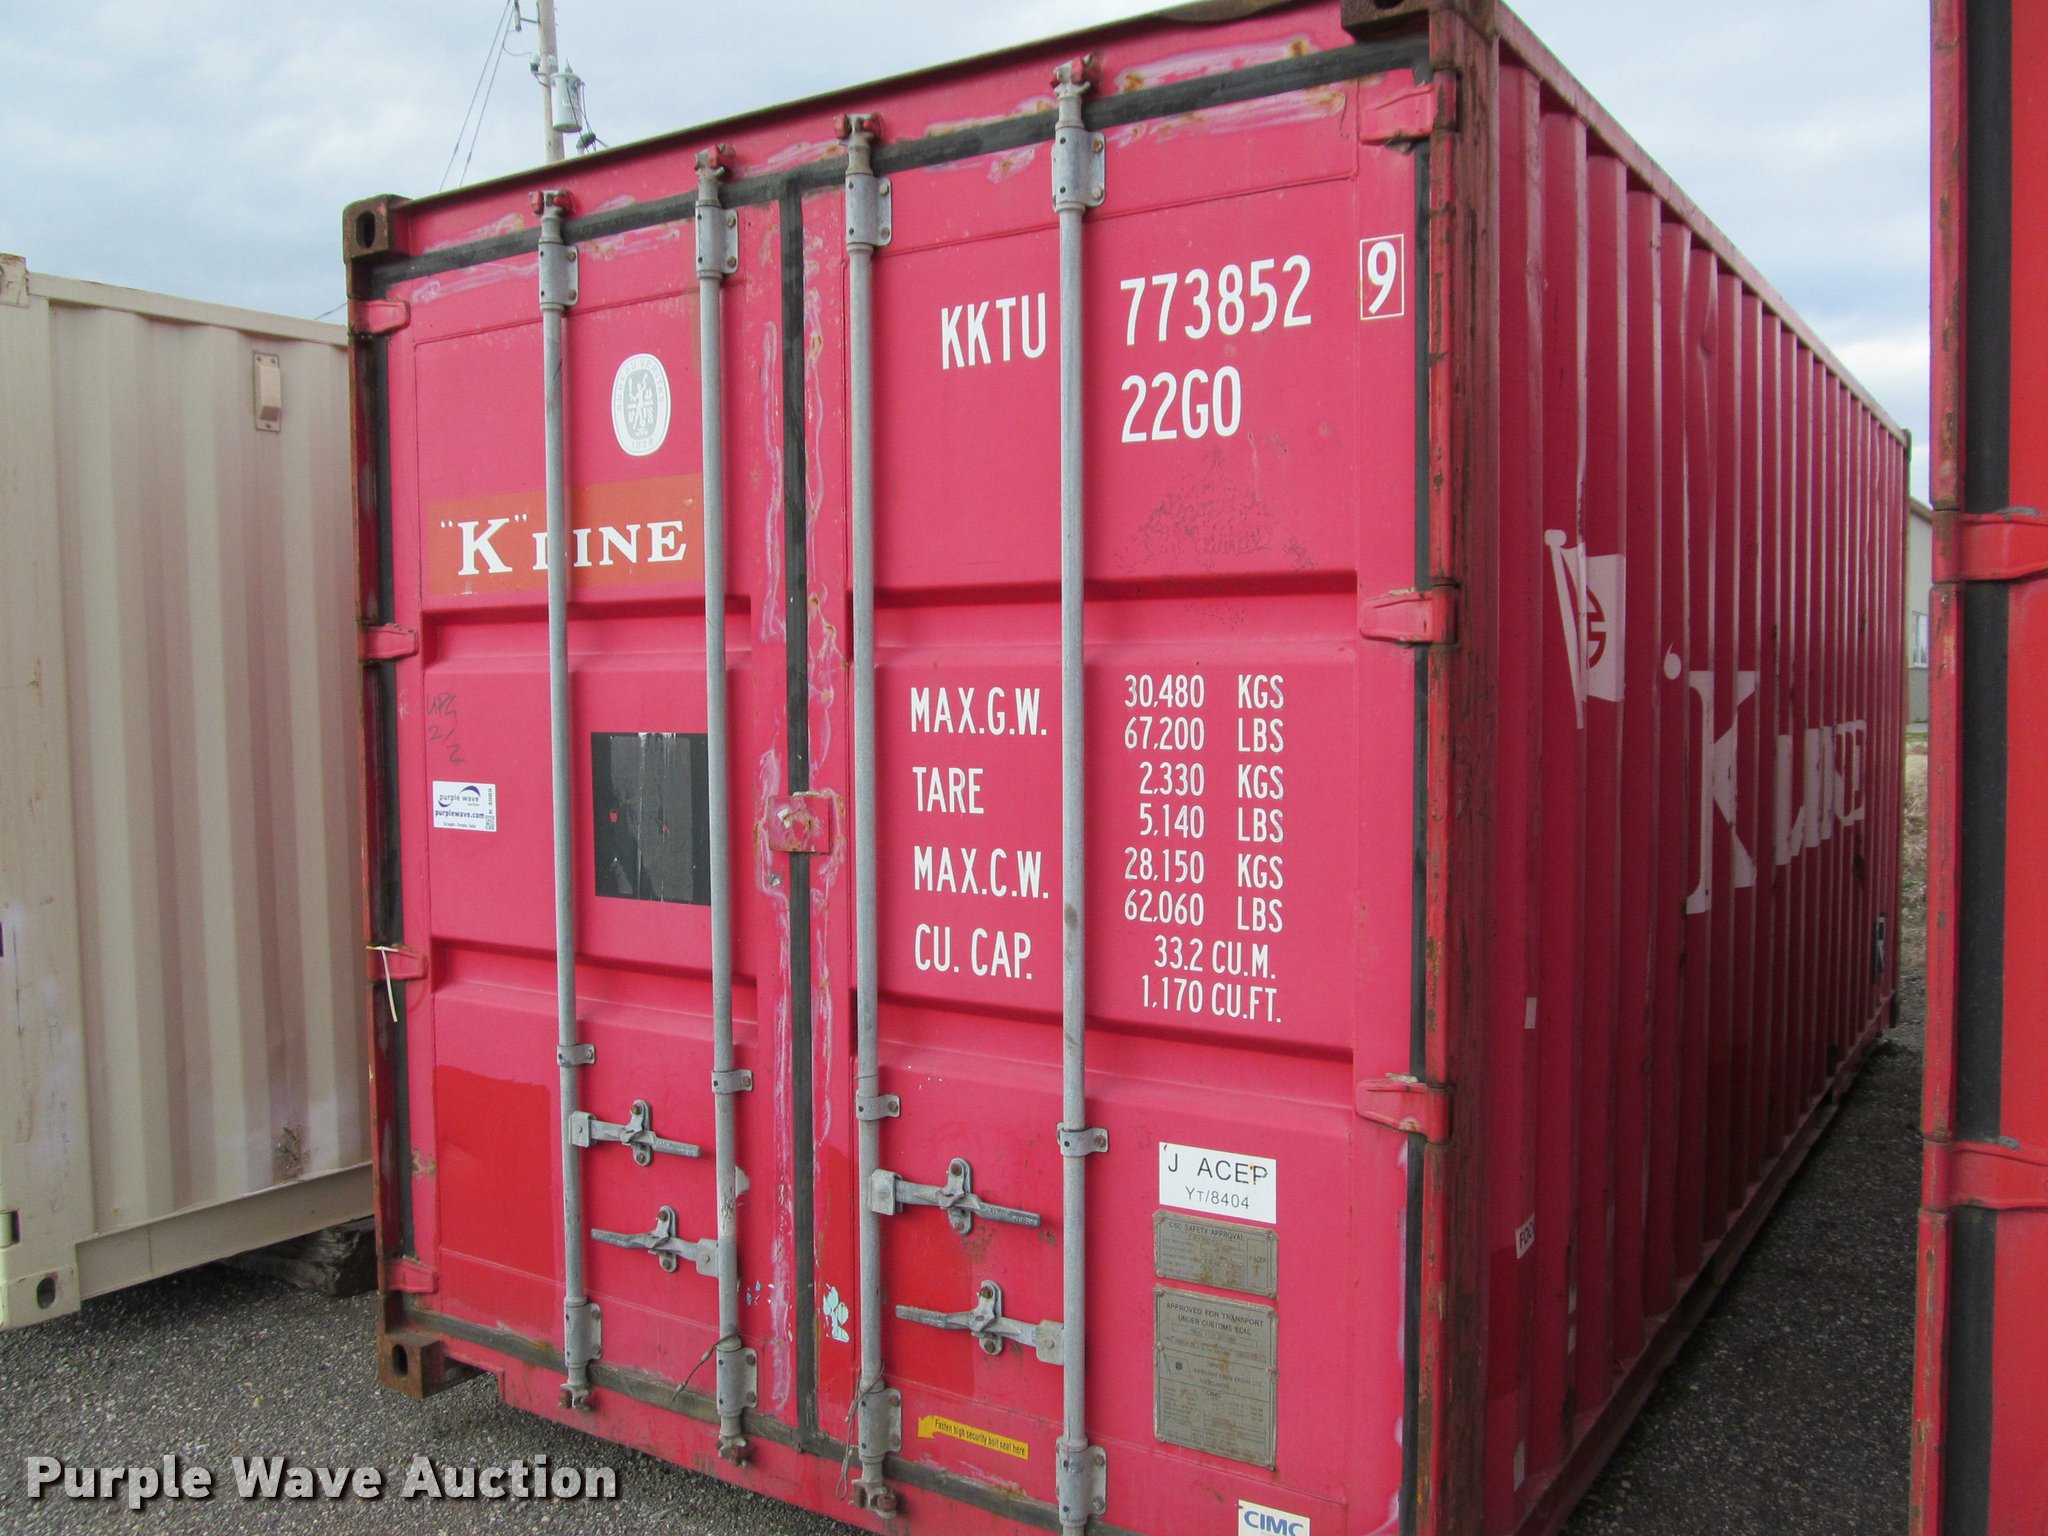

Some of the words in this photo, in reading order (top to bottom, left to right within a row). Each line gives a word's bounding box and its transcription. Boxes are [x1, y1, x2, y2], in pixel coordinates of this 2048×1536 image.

[940, 291, 1048, 370] KKTU
[1119, 254, 1312, 346] 773852
[1367, 241, 1398, 315] 9
[910, 686, 1048, 736] MAX.G.W.
[1124, 674, 1205, 708] 30,480
[1238, 674, 1285, 709] KGS
[1124, 716, 1205, 750] 67,200
[1238, 717, 1284, 753] LBS
[439, 794, 460, 802] purple
[912, 766, 985, 814] TARE
[1139, 761, 1205, 796] 2,330
[1238, 764, 1284, 800] KGS
[435, 809, 485, 819] purplewave.com
[1139, 802, 1205, 839] 5,140
[1238, 807, 1284, 843] LBS
[913, 845, 1049, 899] MAX.C.W.
[1124, 846, 1205, 884] 28,150
[1237, 853, 1284, 890] KGS
[1124, 888, 1205, 926] 62,060
[1237, 896, 1283, 933] LBS
[914, 923, 960, 973] CU.
[971, 927, 1032, 980] CAP.
[1154, 934, 1204, 972] 33.2
[1168, 1152, 1179, 1173] J
[1197, 1157, 1268, 1186] ACEP
[1169, 1221, 1182, 1231] CSC
[1184, 1223, 1208, 1235] SAFETY
[1211, 1229, 1244, 1241] APPROVAL
[1166, 1302, 1203, 1316] APPROVED
[1204, 1309, 1220, 1319] FOR
[1221, 1312, 1264, 1327] TRANSPORT
[1178, 1314, 1200, 1326] UNDER
[1201, 1320, 1233, 1332] CUSTOMS
[1234, 1325, 1252, 1336] SEAL
[935, 1418, 952, 1432] Fasten
[953, 1424, 966, 1438] high
[966, 1430, 987, 1446] security
[999, 1440, 1012, 1452] seal
[1012, 1444, 1026, 1456] here
[1243, 1510, 1304, 1536] CIMC
